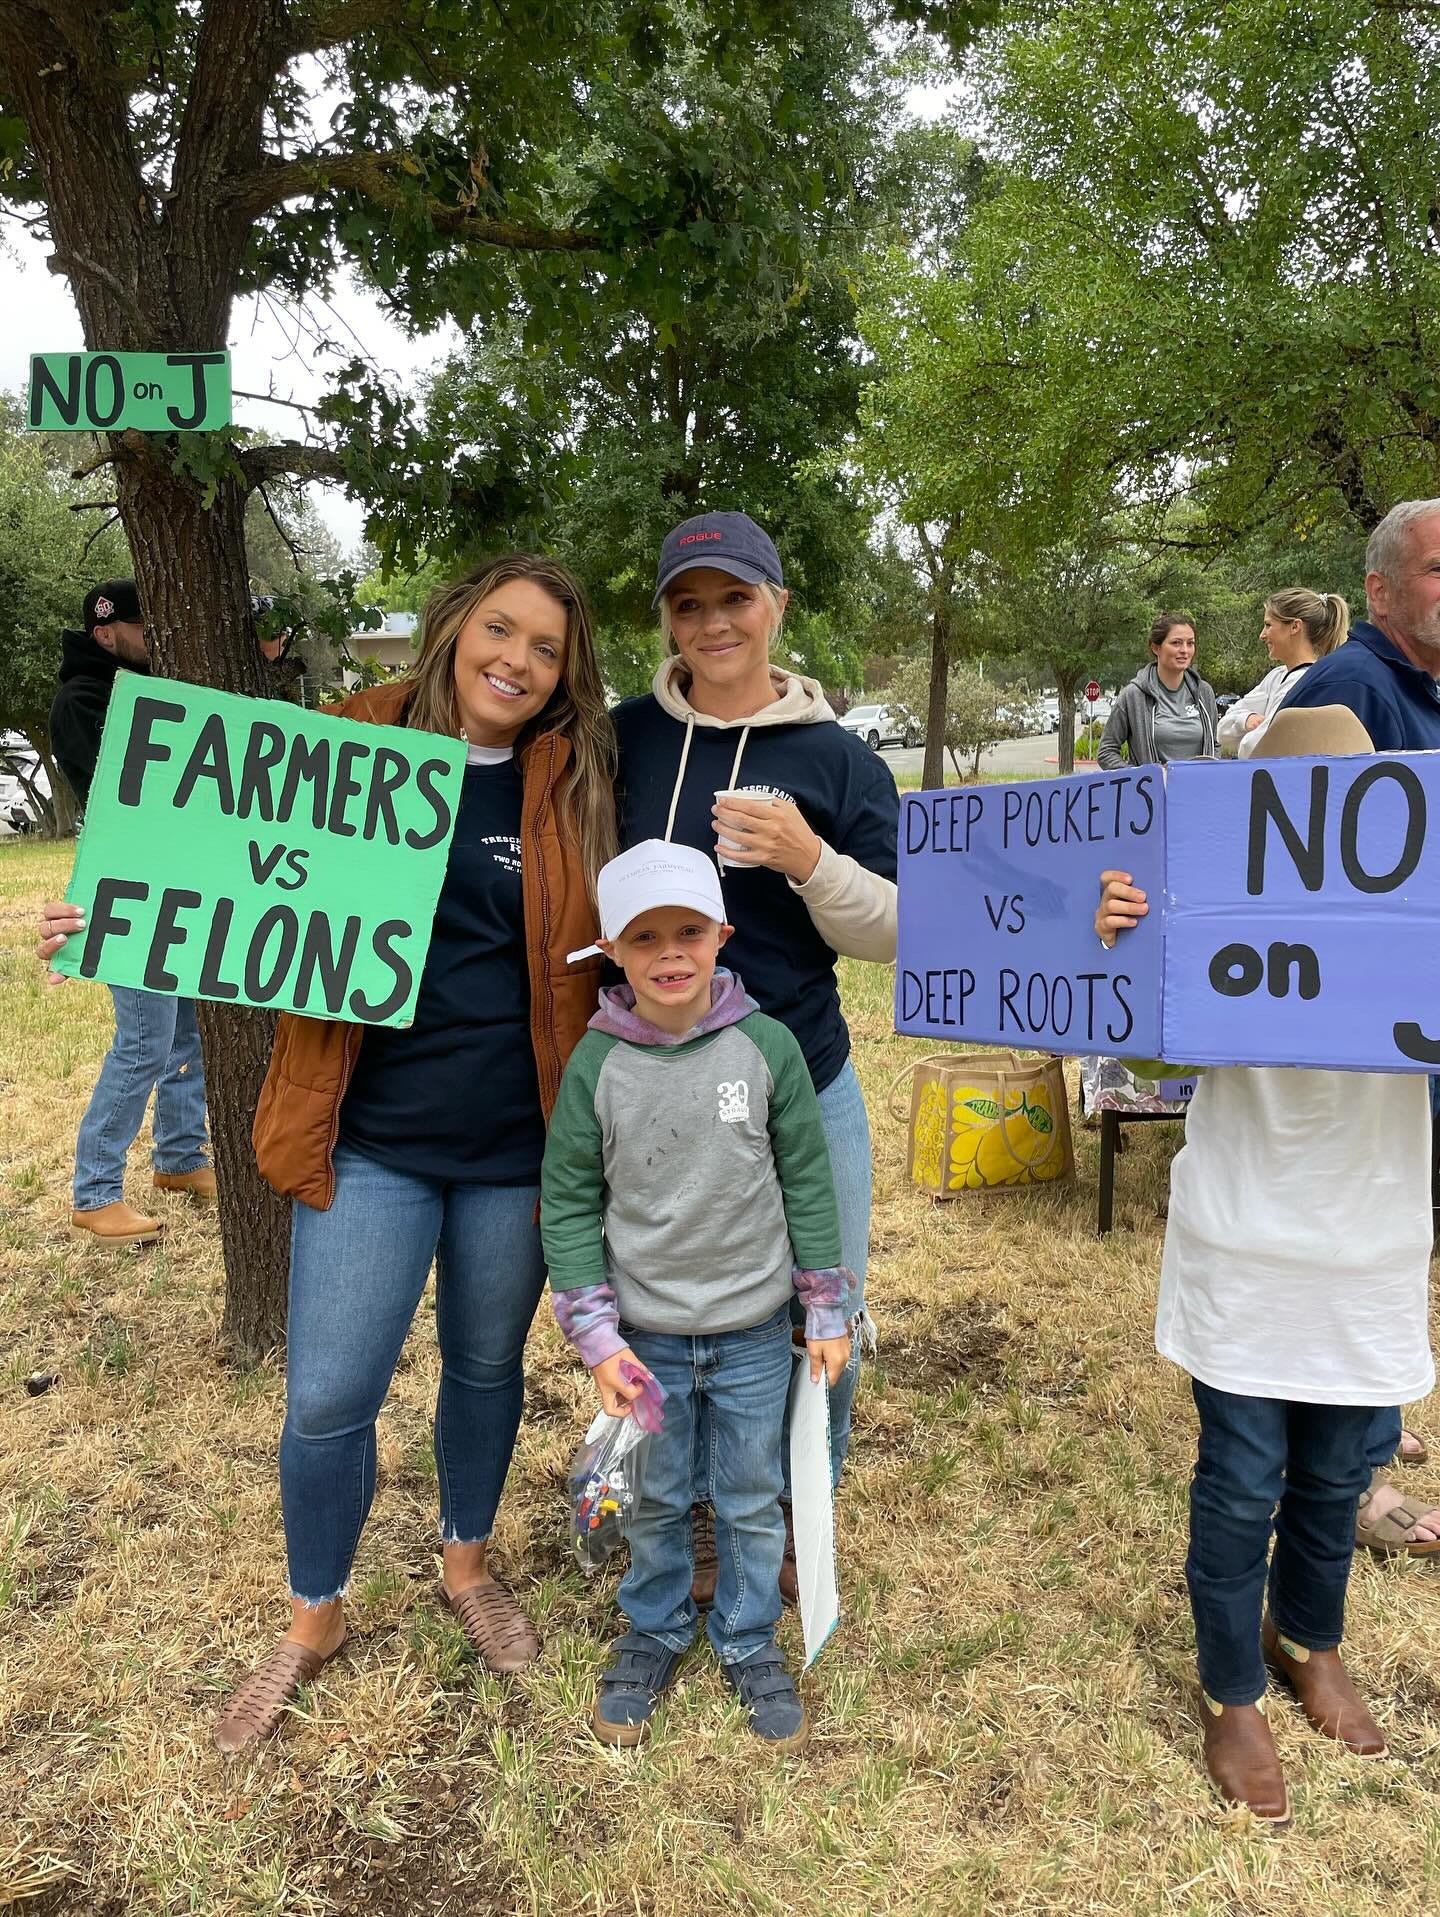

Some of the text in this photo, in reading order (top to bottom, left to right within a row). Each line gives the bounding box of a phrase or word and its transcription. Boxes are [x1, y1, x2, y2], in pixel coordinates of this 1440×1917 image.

[30, 353, 226, 429] NO on J
[680, 532, 721, 545] ROGUE
[1085, 687, 1099, 697] STOP
[117, 696, 452, 850] FARMERS
[480, 836, 521, 845] TRESCH
[906, 775, 1154, 855] DEEP POCKETS
[1246, 760, 1428, 896] NO
[493, 854, 510, 864] TWO
[79, 877, 413, 1022] FELONS
[1208, 941, 1321, 1001] on
[902, 968, 1134, 1043] DEEP ROOTS
[717, 1080, 749, 1109] 30
